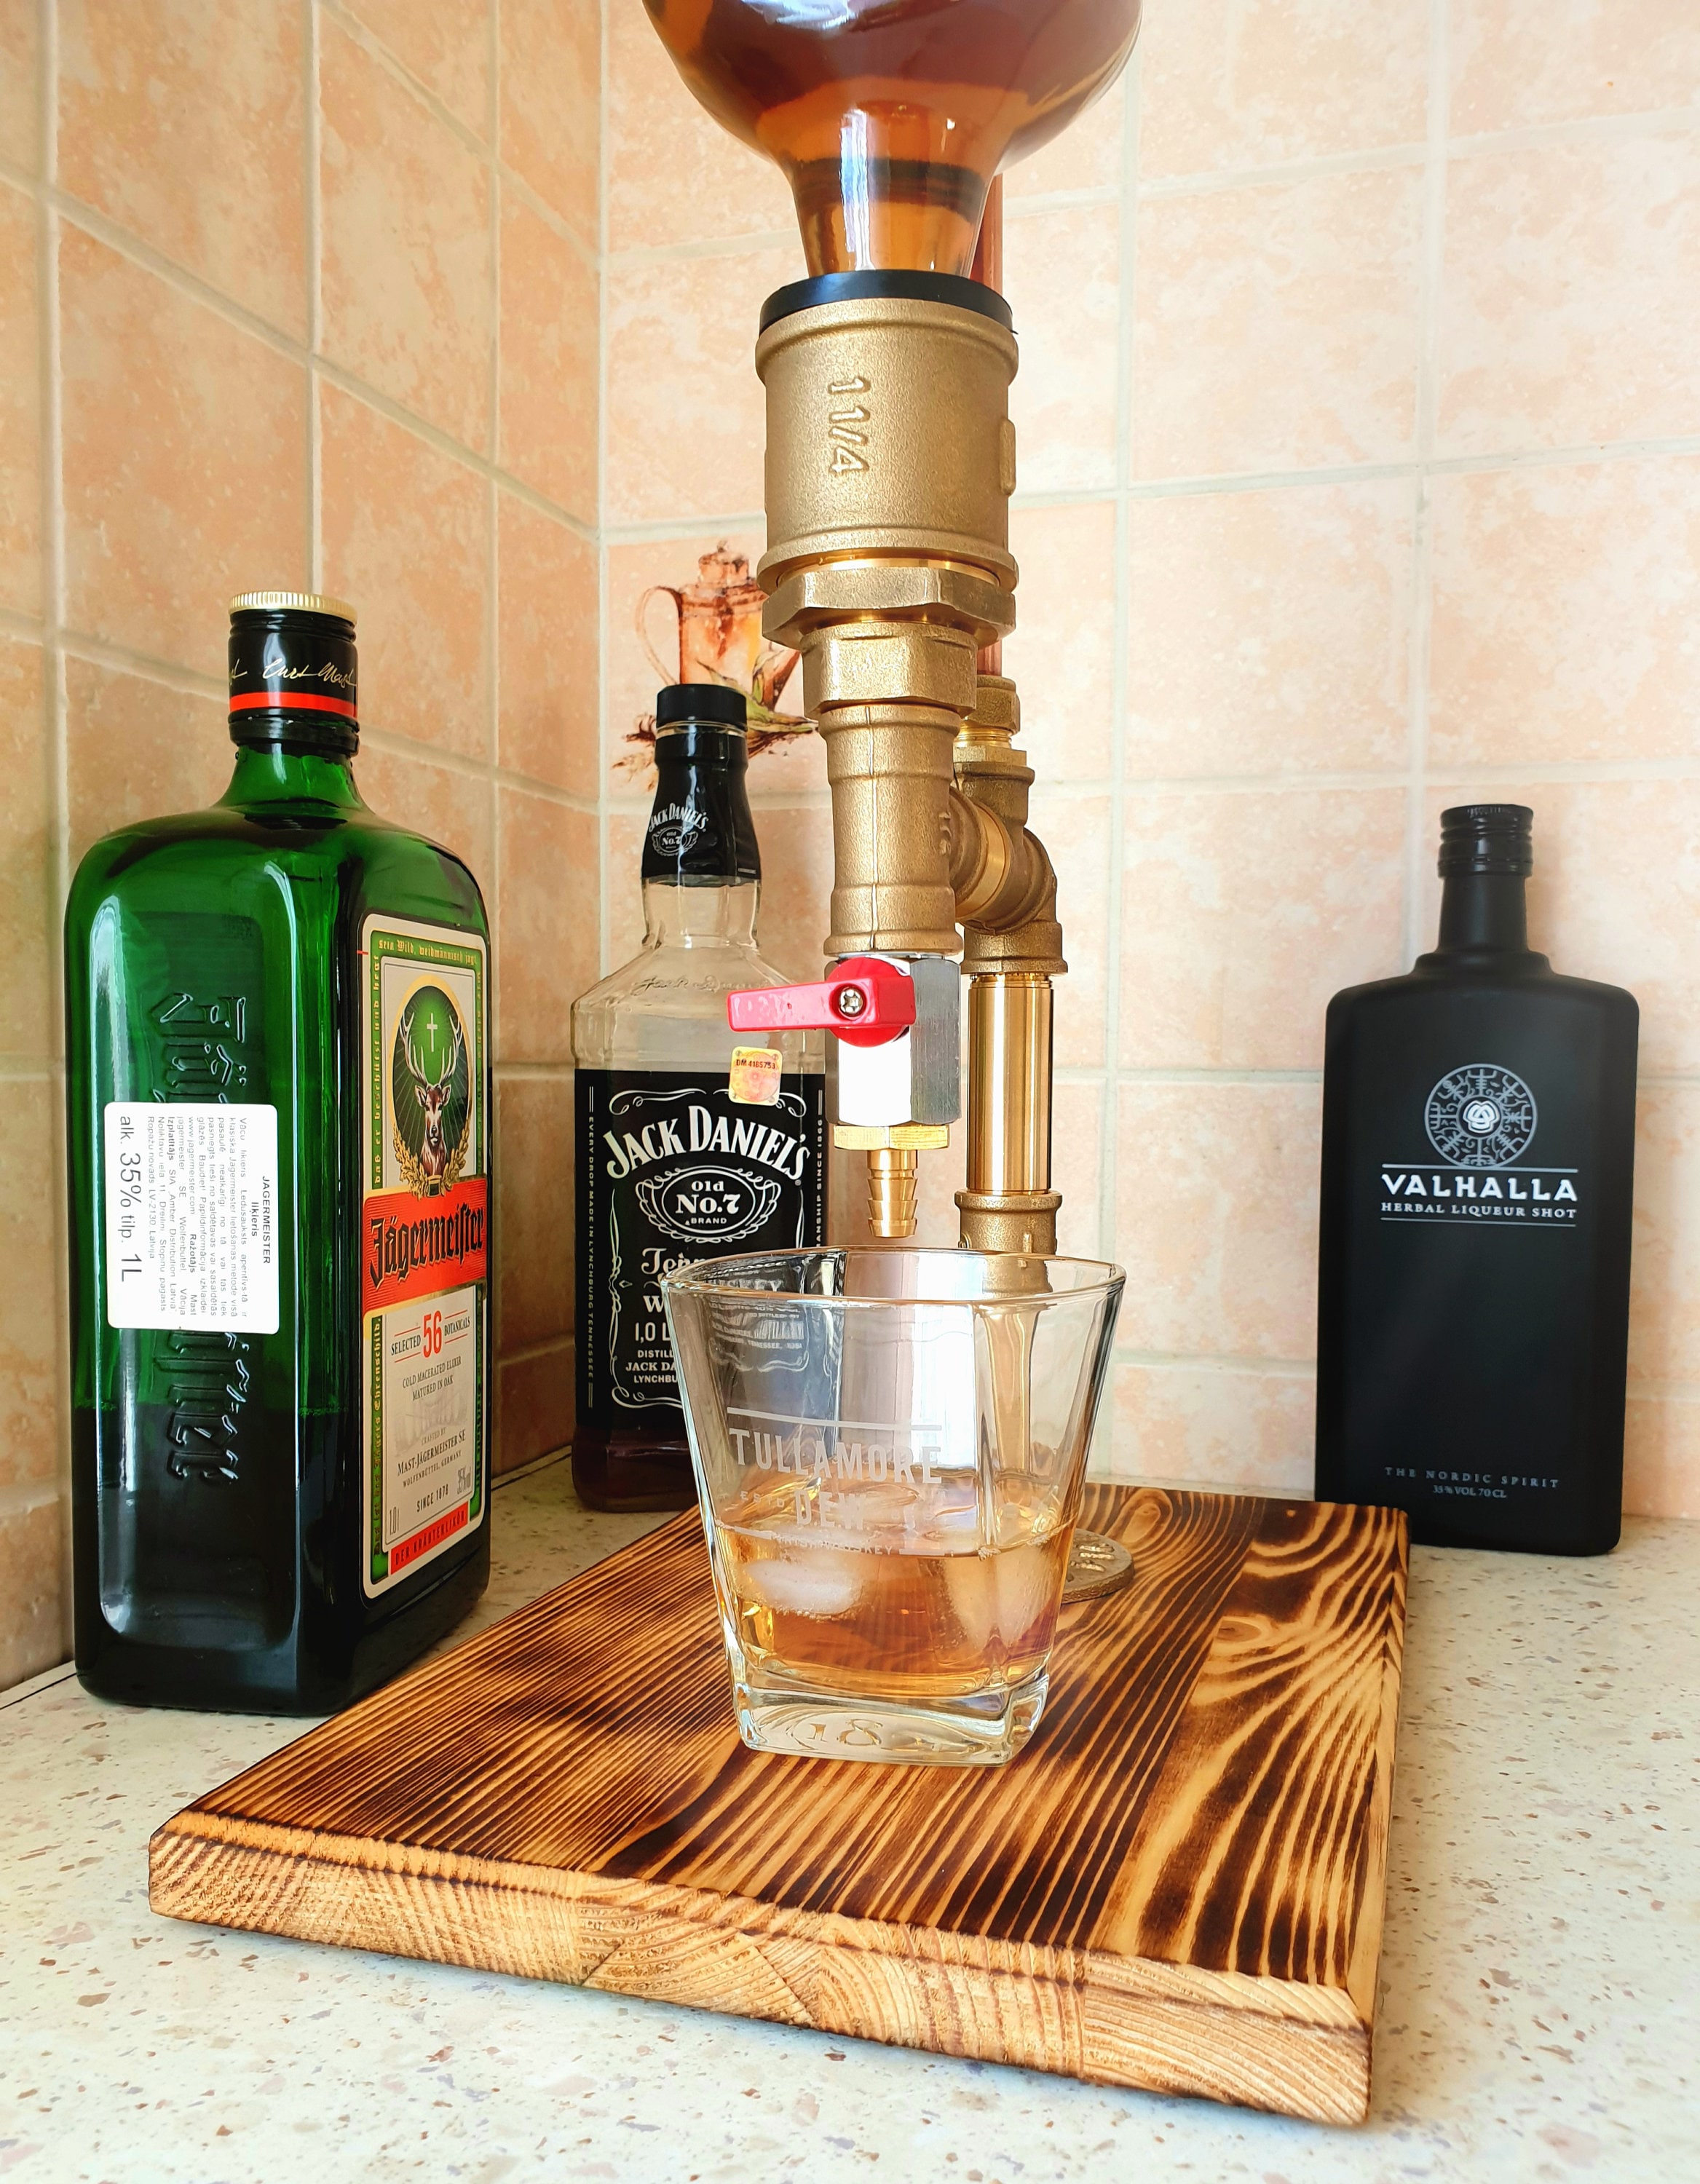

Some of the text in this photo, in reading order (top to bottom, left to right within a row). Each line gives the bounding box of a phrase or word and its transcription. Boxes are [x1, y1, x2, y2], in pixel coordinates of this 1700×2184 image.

[827, 376, 871, 395] 1
[649, 802, 709, 833] JACK DANIEL'S
[207, 1117, 216, 1159] pasniegts
[218, 1117, 226, 1152] pasaulē
[602, 1104, 810, 1181] JACK DANIEL'S
[210, 1186, 215, 1196] no
[691, 1181, 725, 1192] Old
[1381, 1174, 1578, 1202] VALHALLA
[118, 1116, 142, 1282] alk. 35% tilp. 1L
[675, 1194, 741, 1215] No.7
[691, 1216, 727, 1224] BRAND
[1380, 1202, 1578, 1219] HERBAL LIQUEUR SHOT
[221, 1216, 225, 1227] no
[588, 1225, 595, 1237] IN
[391, 1309, 471, 1359] SELECTED 56 BOTANICALS
[635, 1321, 656, 1343] 1,0
[403, 1378, 417, 1389] COLD
[418, 1364, 446, 1382] MACERATED
[626, 1361, 658, 1372] JACK
[413, 1374, 454, 1401] MATURED IN OAK
[459, 1429, 467, 1441] SE
[441, 1449, 463, 1467] GERMANY
[729, 1428, 942, 1485] TULLAMORE
[1385, 1467, 1559, 1488] THE NORDIC SPIRIT
[416, 1484, 449, 1513] SINCE 1878
[1454, 1487, 1476, 1495] VOL
[395, 1548, 410, 1565] DER
